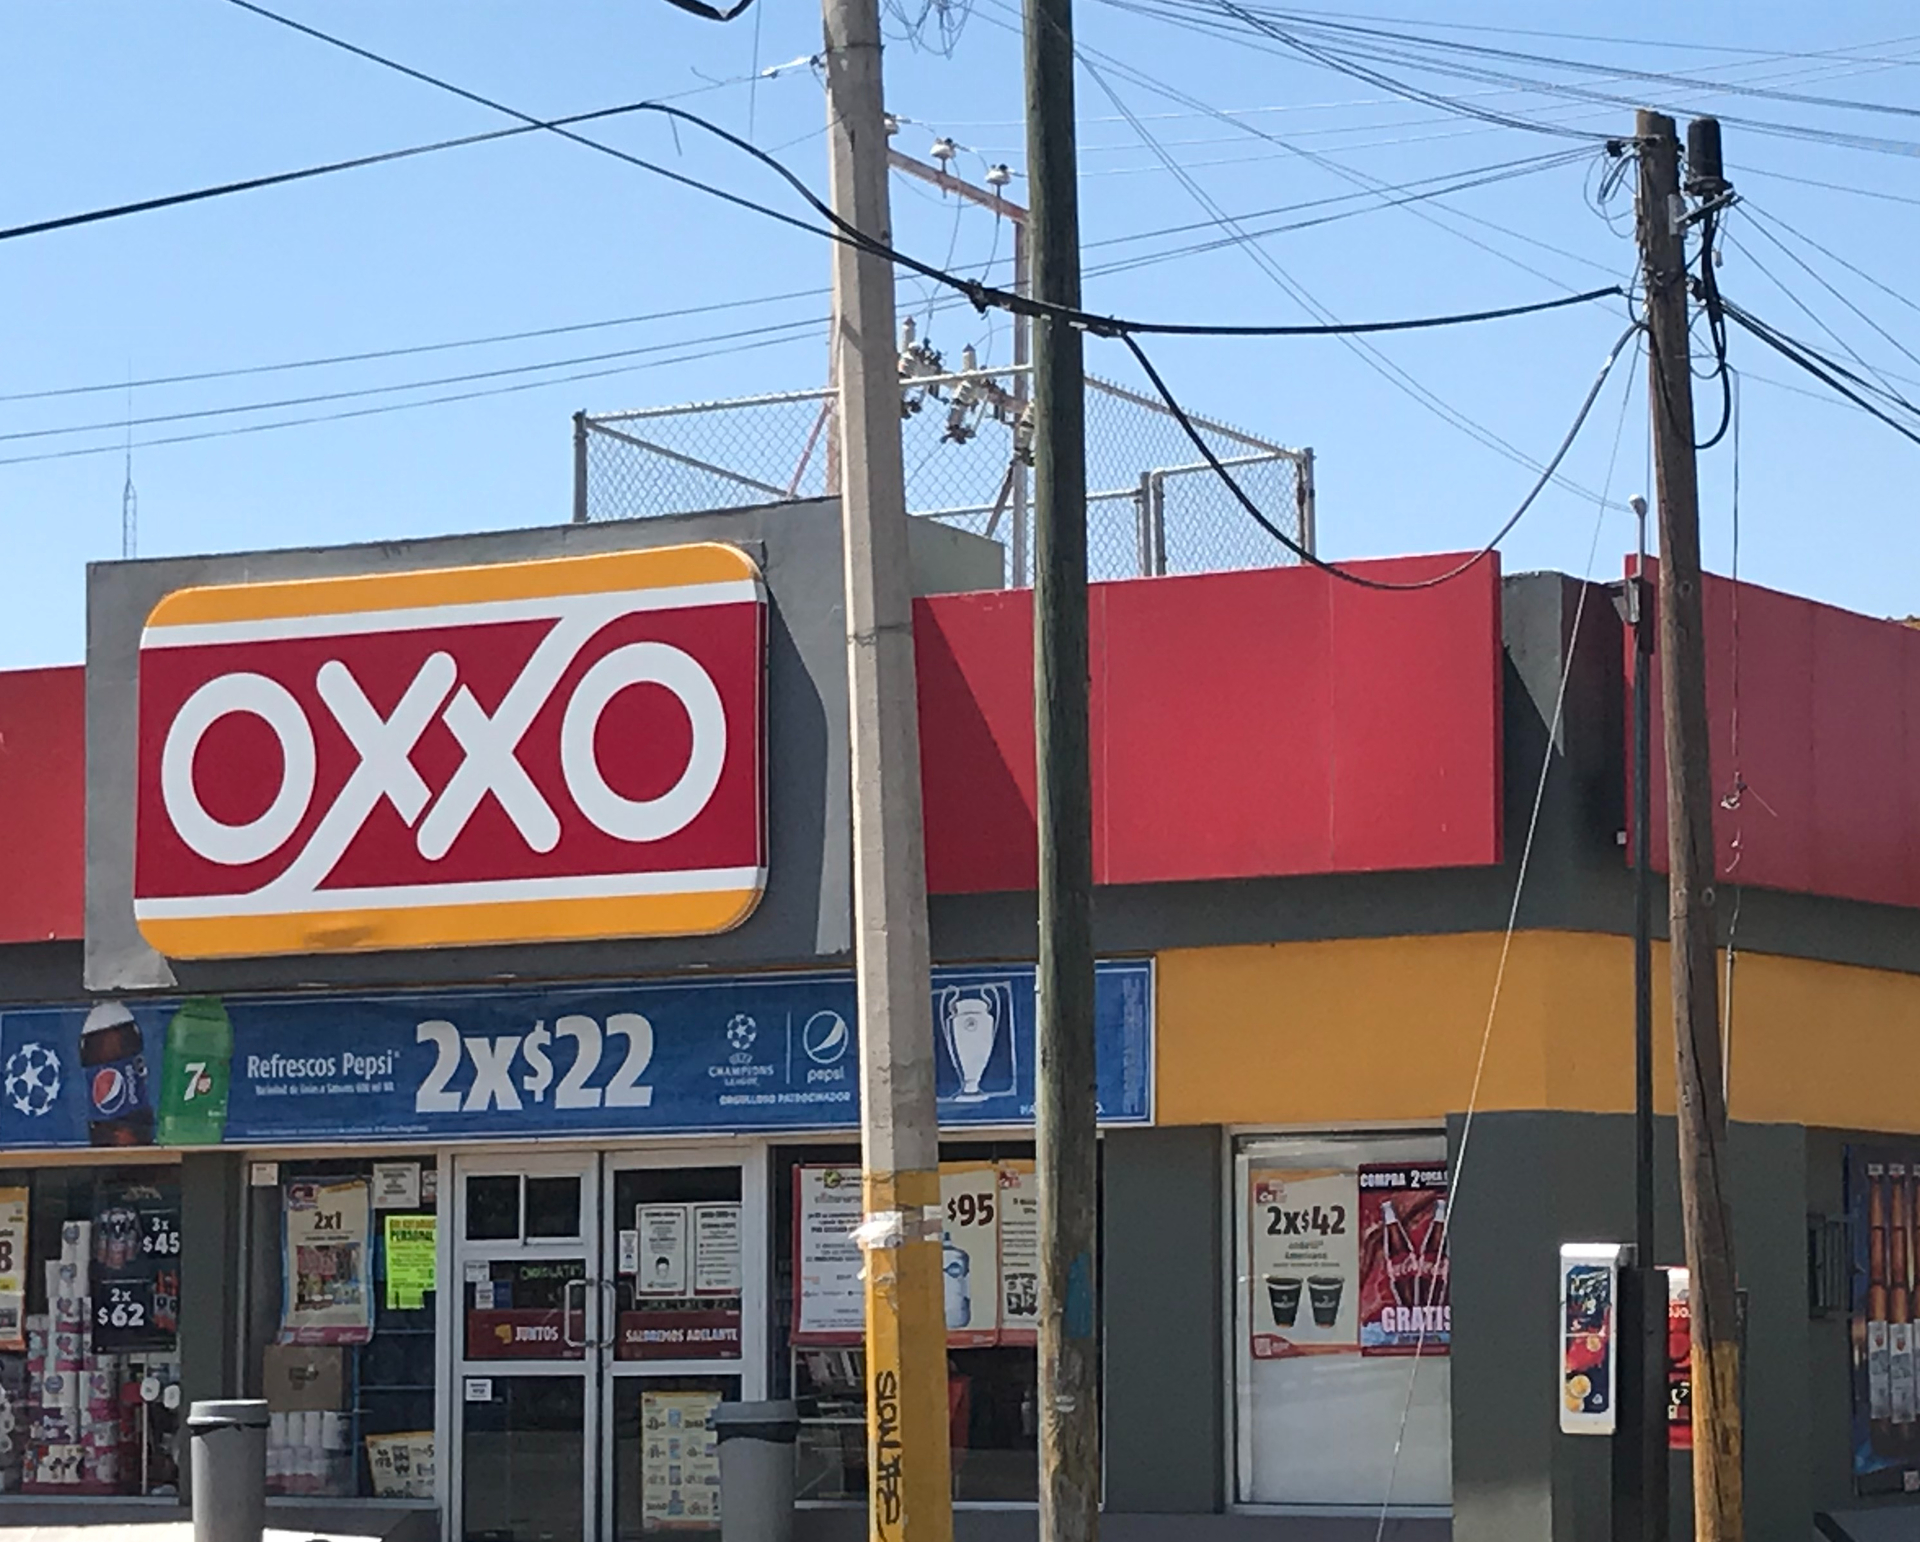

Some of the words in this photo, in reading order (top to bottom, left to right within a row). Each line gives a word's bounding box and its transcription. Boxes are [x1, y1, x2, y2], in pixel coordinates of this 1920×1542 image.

[160, 622, 727, 888] OXXO
[247, 1053, 337, 1079] Refrescos
[342, 1049, 393, 1081] Pepsi
[415, 1013, 654, 1113] 2x$22
[708, 1065, 775, 1078] CHAMPIONS
[1361, 1172, 1406, 1187] COMPRA
[1410, 1169, 1421, 1188] 2
[314, 1210, 342, 1230] 2x1
[947, 1193, 994, 1227] $95
[1267, 1206, 1346, 1236] 2x$42
[142, 1231, 181, 1255] $45
[97, 1302, 146, 1328] $62
[1381, 1305, 1451, 1333] GRATIS
[514, 1326, 559, 1342] JUNTOS
